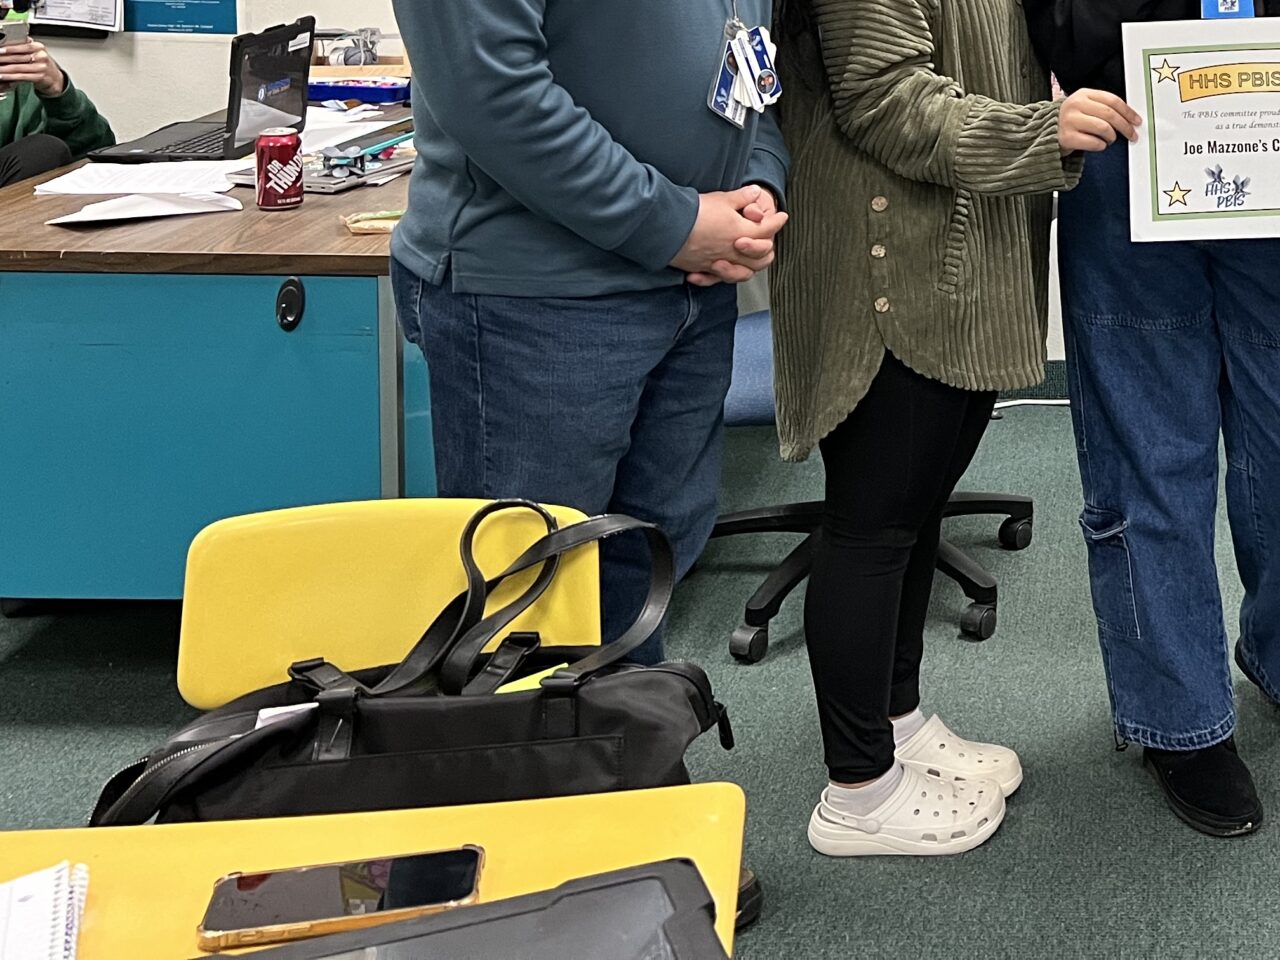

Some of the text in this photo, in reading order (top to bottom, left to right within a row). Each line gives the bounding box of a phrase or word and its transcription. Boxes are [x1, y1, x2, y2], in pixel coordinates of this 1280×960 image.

[1188, 72, 1232, 90] HHS
[1183, 111, 1195, 119] The
[1197, 110, 1219, 119] PBIS
[1220, 109, 1257, 119] committee
[1231, 121, 1247, 130] true
[1183, 141, 1203, 155] Joe
[1207, 139, 1268, 154] Mazzone's
[267, 159, 284, 174] DR
